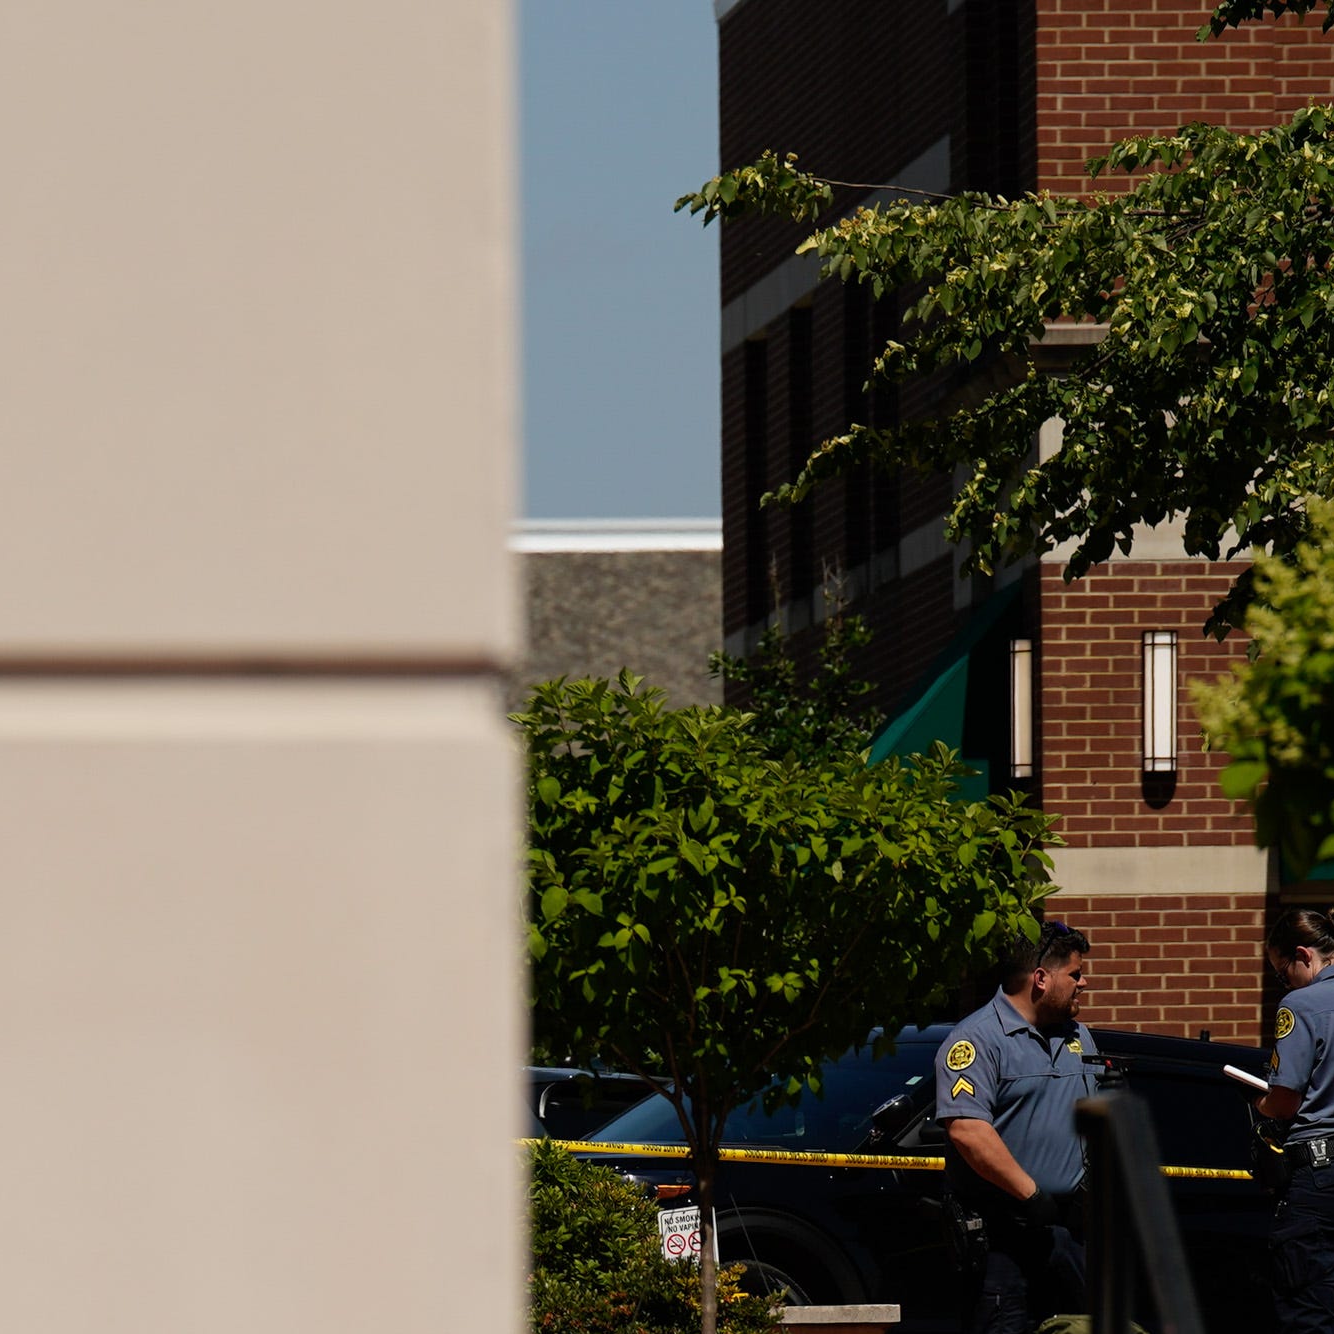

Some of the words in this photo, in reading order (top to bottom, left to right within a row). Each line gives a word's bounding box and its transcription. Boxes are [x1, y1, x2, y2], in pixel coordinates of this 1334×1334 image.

[664, 1217, 674, 1225] NO
[675, 1214, 700, 1223] SMOKI
[667, 1224, 678, 1233] NO
[679, 1222, 699, 1231] VAPIN
